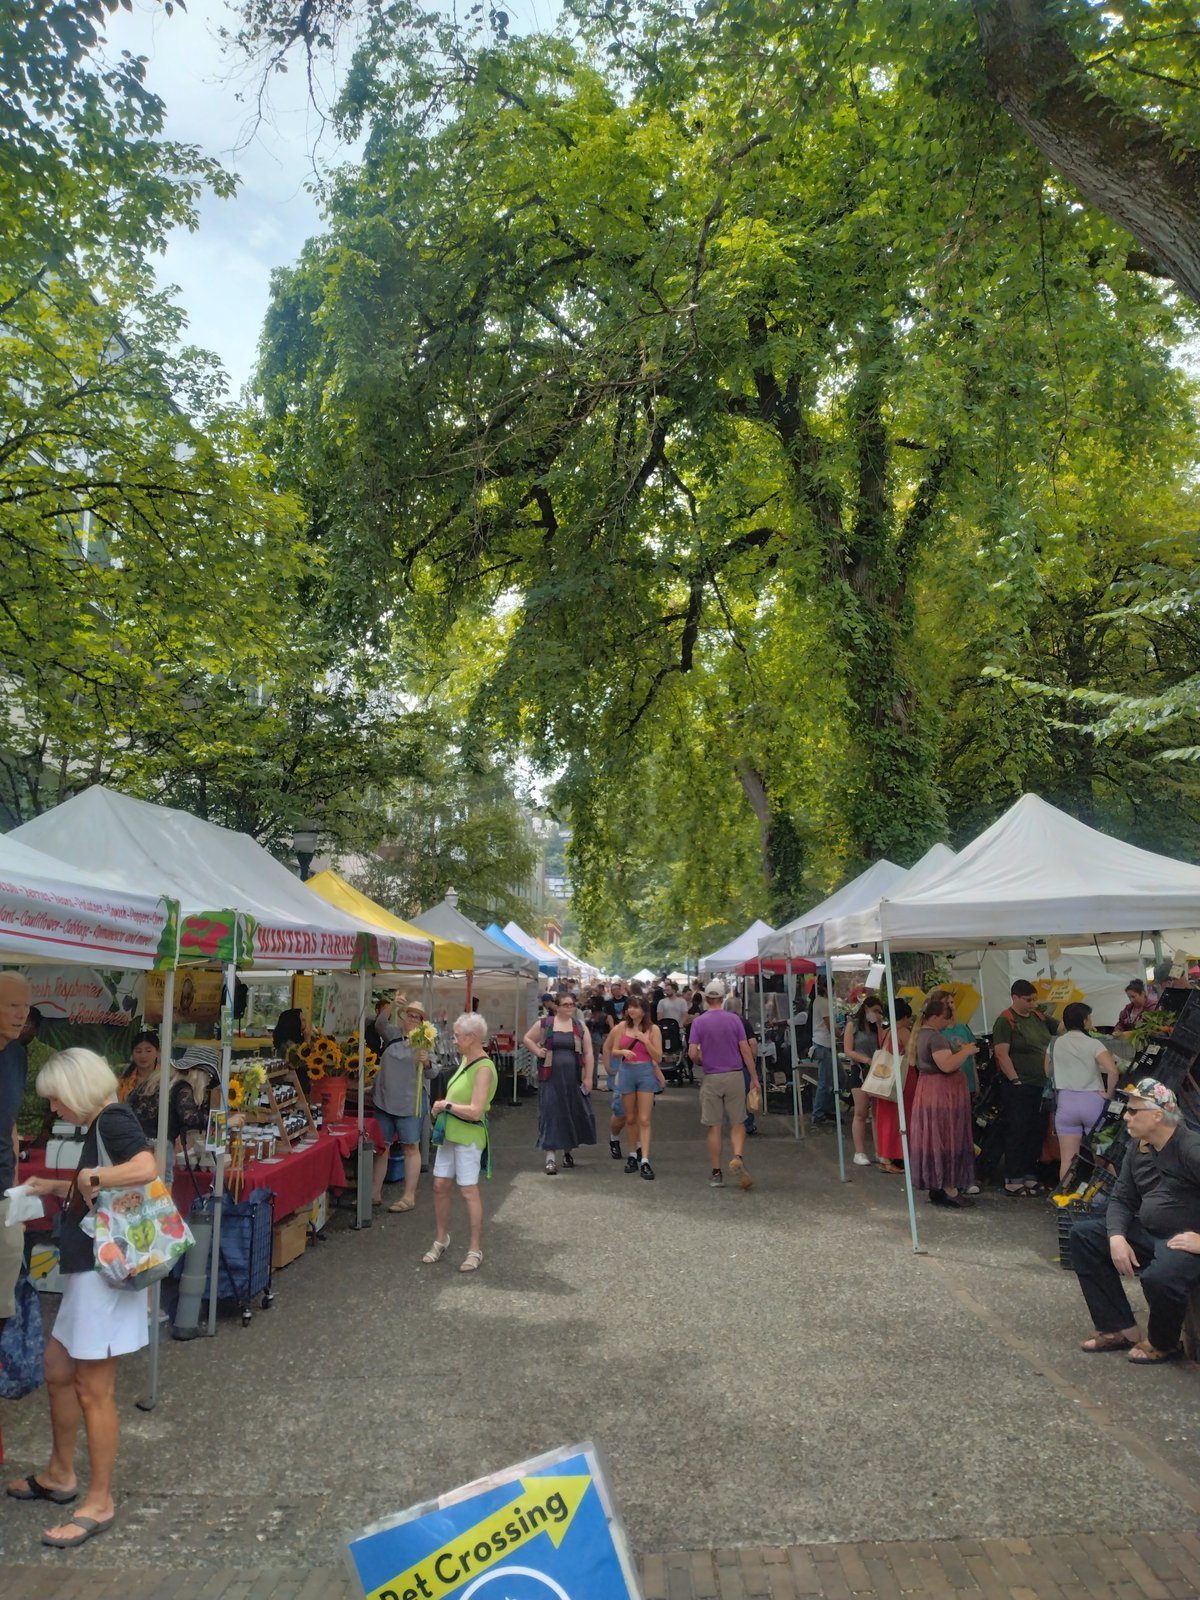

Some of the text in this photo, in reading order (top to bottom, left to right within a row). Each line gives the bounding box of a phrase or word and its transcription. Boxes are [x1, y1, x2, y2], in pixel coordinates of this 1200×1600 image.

[21, 910, 60, 931] Cauliflower
[63, 919, 90, 941] Cabbage
[257, 927, 317, 953] WINTERS
[320, 933, 354, 955] FARMS
[54, 977, 104, 1000] Raspberries
[434, 1491, 569, 1584] Crossing
